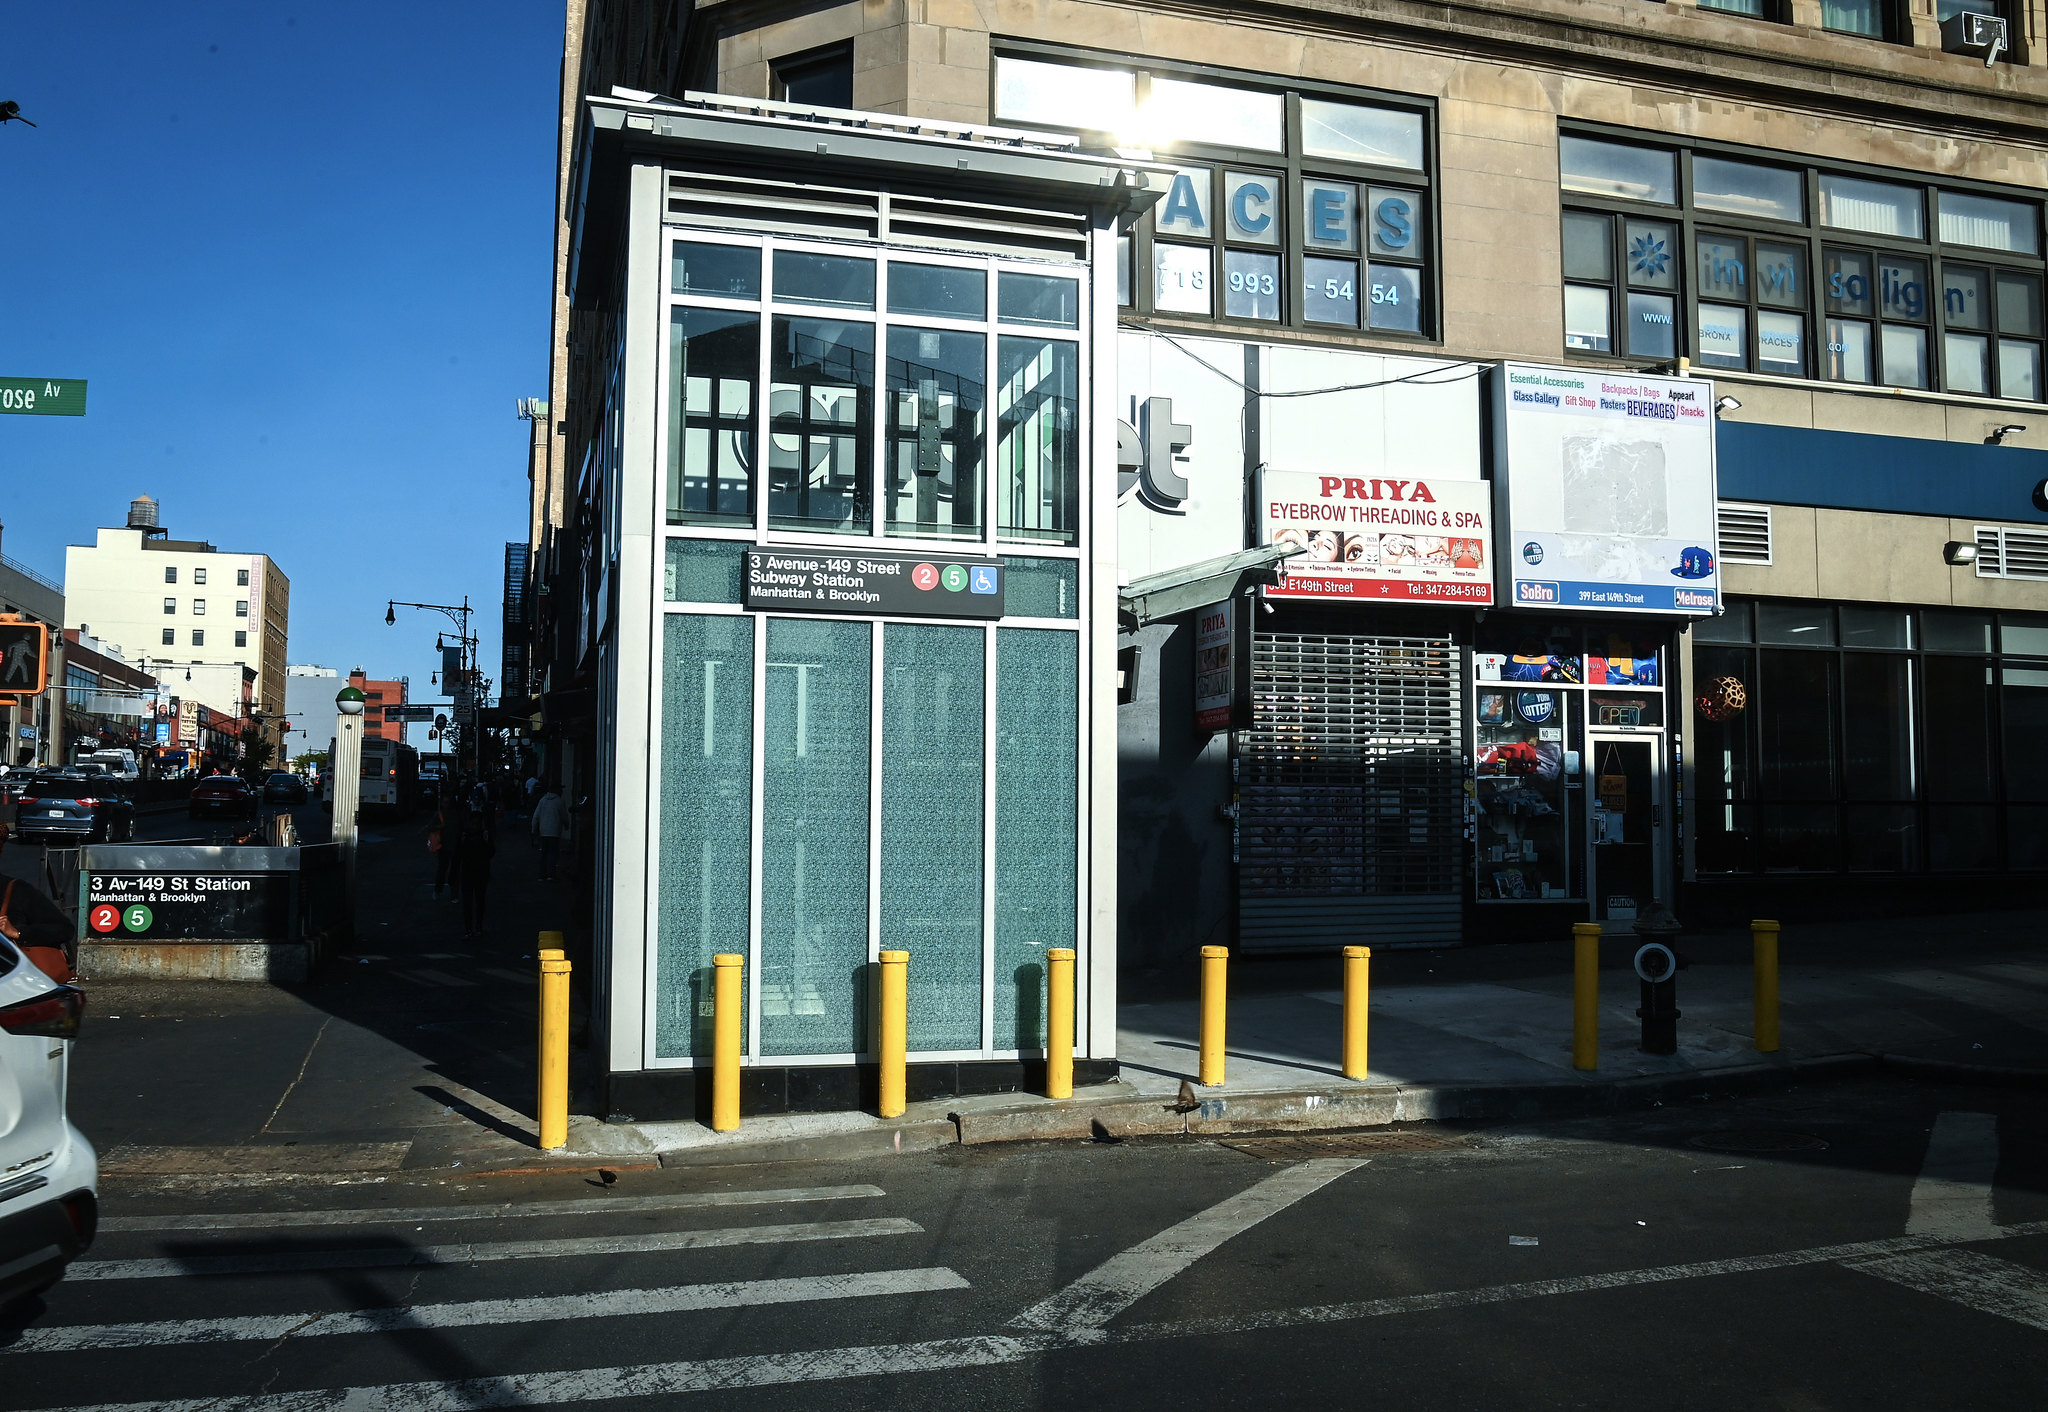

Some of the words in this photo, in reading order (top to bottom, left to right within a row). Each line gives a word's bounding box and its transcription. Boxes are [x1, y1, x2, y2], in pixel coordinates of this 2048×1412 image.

[1229, 272, 1274, 295] 993
[1510, 372, 1542, 385] Essential
[1543, 376, 1585, 389] Accessories
[0, 389, 35, 409] ose
[44, 381, 61, 397] Av
[1513, 390, 1533, 402] Glass
[1534, 392, 1560, 407] Gallery
[1601, 383, 1638, 396] Backpacks
[1643, 386, 1660, 399] Bags
[1668, 389, 1695, 401] Appearl
[1565, 395, 1577, 406] Gift
[1578, 396, 1596, 410] Shop
[1600, 398, 1626, 410] Posters
[1627, 400, 1676, 420] BEVERAGES
[1680, 406, 1705, 418] Snacks
[1319, 476, 1436, 503] PRIYA
[1270, 502, 1346, 522] EYEBROW
[1350, 506, 1437, 526] THREADING
[1442, 511, 1451, 528] &
[1455, 511, 1483, 528] SPA
[751, 555, 761, 568] 3
[857, 560, 900, 575] Street
[750, 570, 807, 587] Subway
[813, 573, 864, 588] Station
[920, 569, 932, 584] 2
[949, 571, 960, 586] 5
[1289, 579, 1323, 592] E149th
[1324, 581, 1354, 593] Street
[1407, 583, 1424, 595] Tel:
[1425, 584, 1487, 597] 347-284-5169
[1520, 583, 1553, 601] SoBro
[751, 586, 812, 599] Manhattan
[816, 590, 825, 600] &
[829, 590, 880, 603] Brooklyn
[1578, 591, 1591, 601] 399
[1591, 592, 1606, 602] East
[1606, 592, 1624, 603] 149th
[1624, 593, 1644, 603] Street
[1676, 591, 1714, 606] Melrose
[1201, 613, 1225, 634] PRIYA
[456, 705, 470, 713] 25
[1601, 708, 1638, 724] OPEN
[92, 877, 103, 891] 3
[171, 877, 189, 891] St
[195, 877, 251, 891] Station
[90, 892, 145, 902] Manhattan
[149, 893, 156, 902] &
[160, 892, 206, 904] Brooklyn
[1609, 897, 1635, 907] CAUTION
[99, 910, 112, 926] 2
[131, 910, 144, 926] 5
